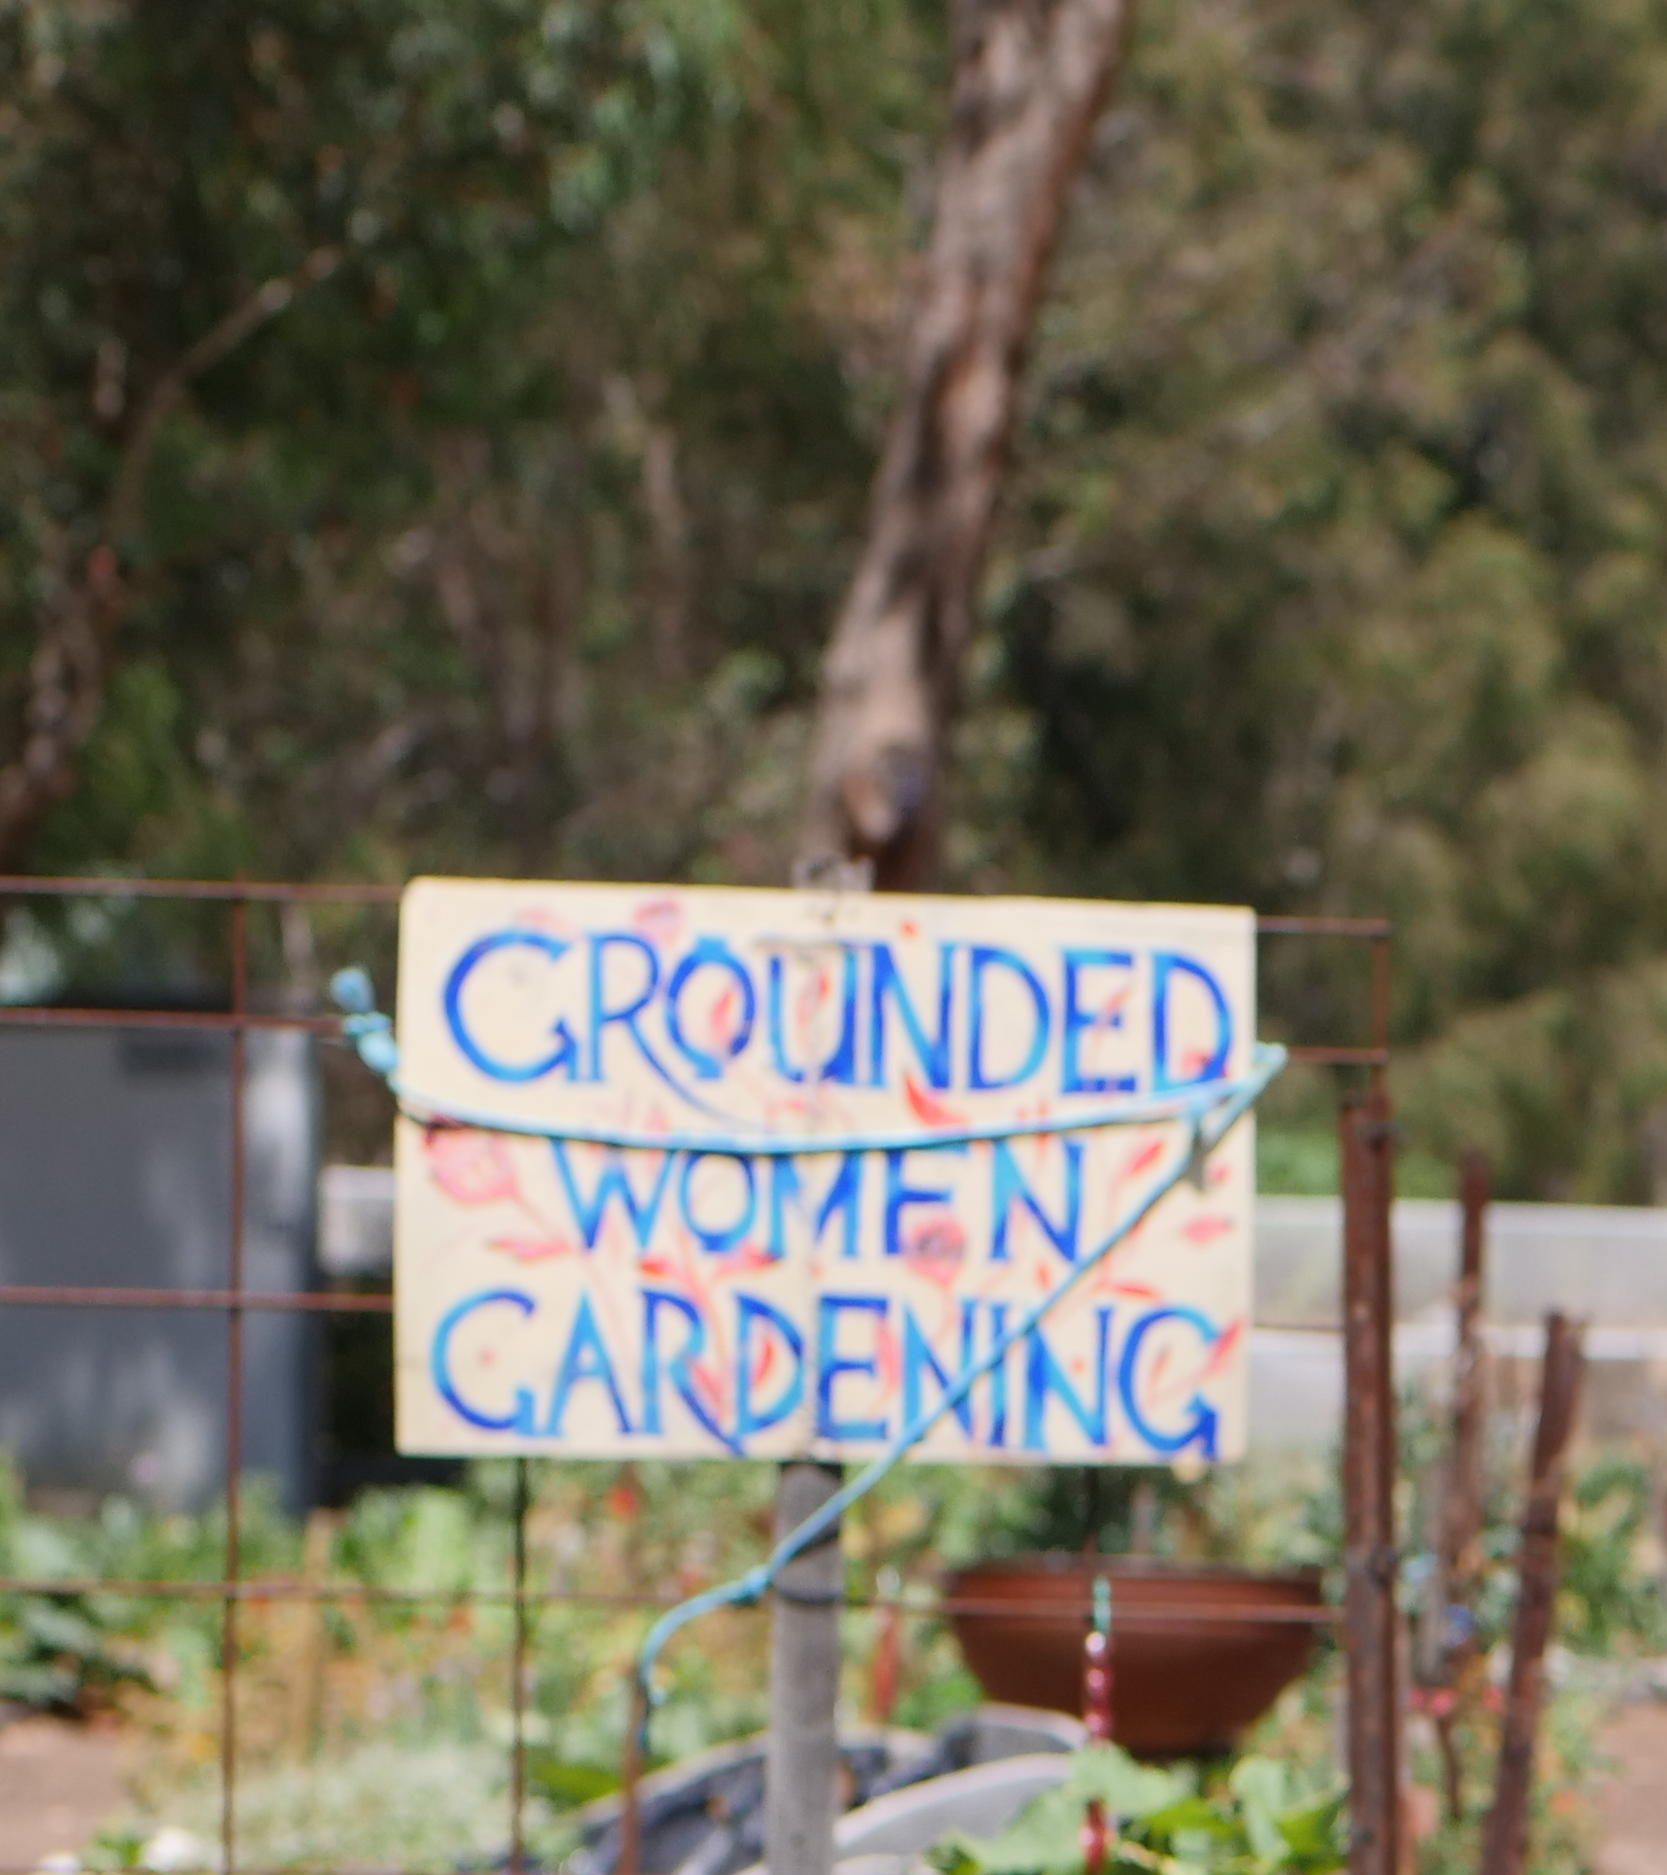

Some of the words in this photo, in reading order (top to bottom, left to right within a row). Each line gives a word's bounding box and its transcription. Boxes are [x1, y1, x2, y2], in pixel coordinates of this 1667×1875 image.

[442, 927, 1233, 1112] GROUNDED
[551, 1134, 1085, 1262] WOMEN
[431, 1289, 1221, 1460] GARDENING
